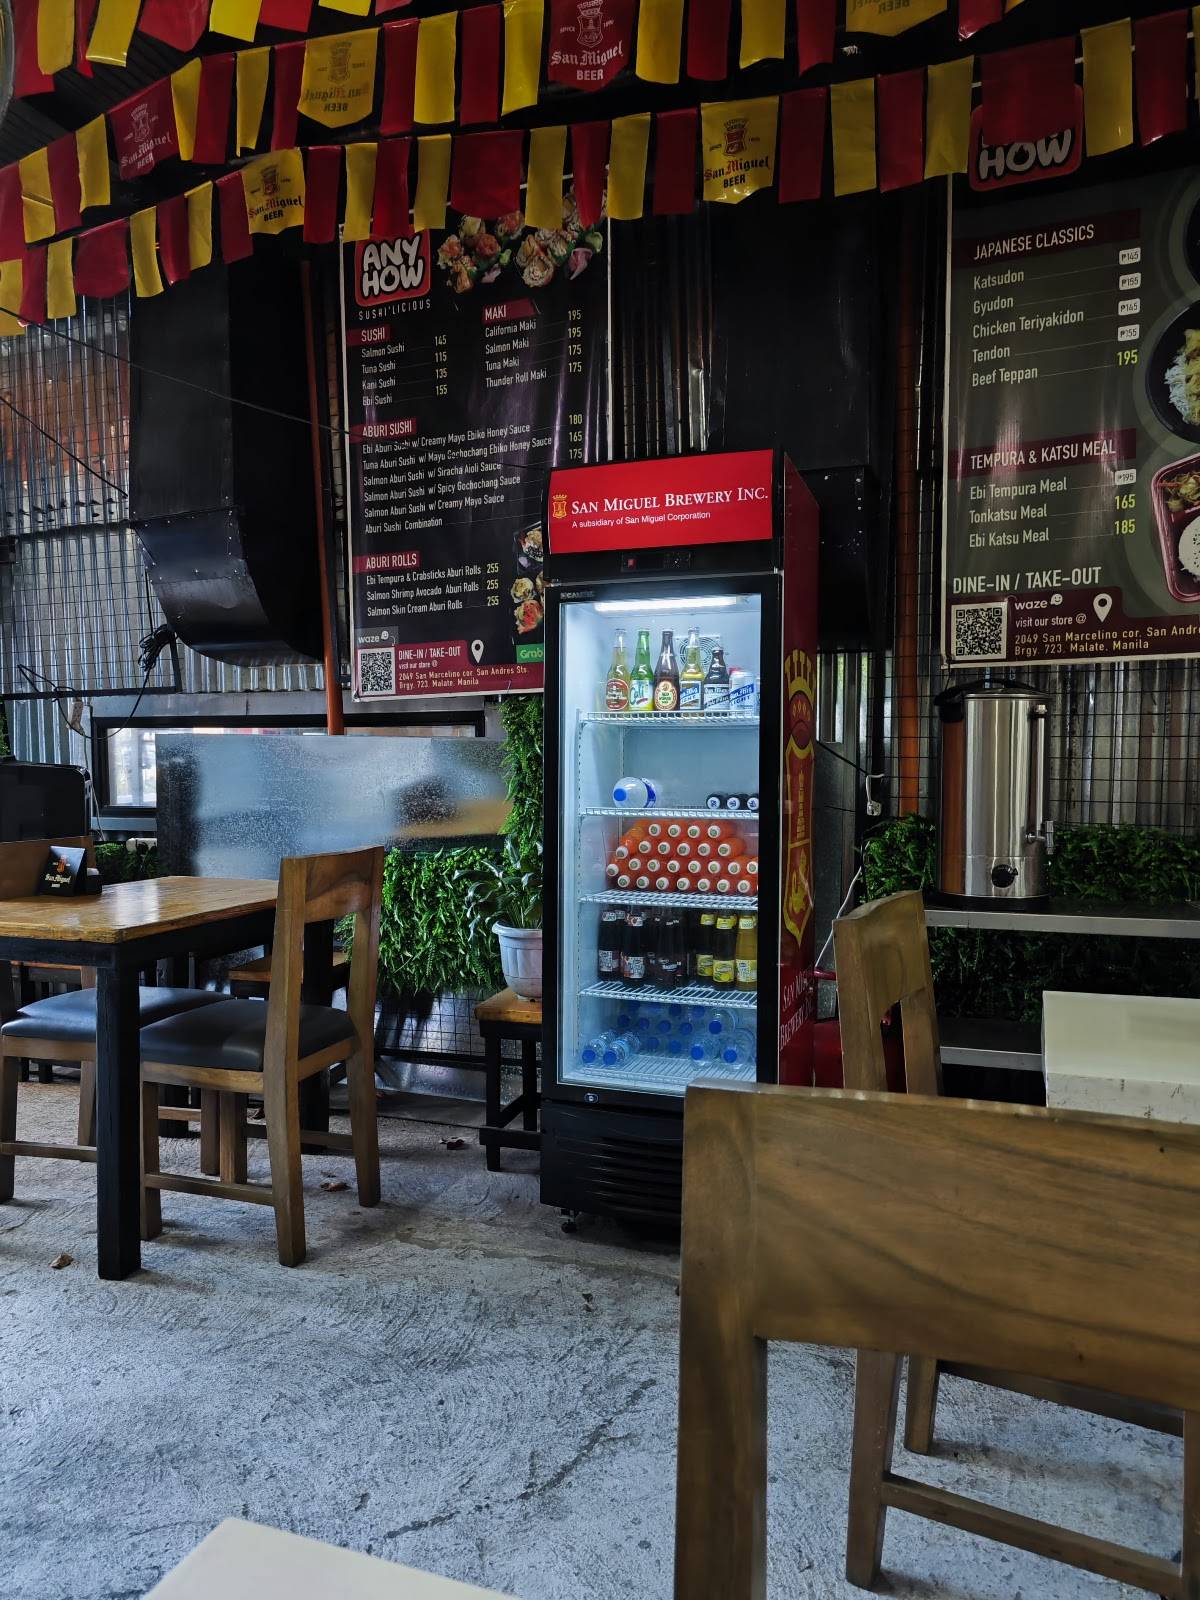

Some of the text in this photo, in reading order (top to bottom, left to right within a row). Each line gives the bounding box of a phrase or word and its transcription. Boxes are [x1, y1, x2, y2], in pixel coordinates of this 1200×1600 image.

[551, 39, 624, 66] San Miguel
[576, 68, 604, 81] BEER
[979, 128, 1072, 180] HOW
[723, 174, 746, 189] BEER
[263, 209, 284, 222] BEER
[973, 223, 1095, 261] JAPANESE CLASSICS
[363, 234, 421, 272] ANY
[362, 258, 424, 298] HOW
[973, 269, 1025, 290] Katsudon
[485, 304, 507, 320] MAKI
[568, 309, 582, 321] 195
[973, 296, 1014, 317] Gyudon
[485, 318, 537, 338] California Maki
[568, 326, 582, 339] 195
[973, 309, 1085, 340] Chicken Teriyakidon
[361, 326, 386, 342] SUSHI
[361, 341, 405, 358] Salmon Sushi
[485, 337, 530, 355] Salmon Maki
[568, 344, 582, 356] 175
[972, 344, 1011, 363] Tendon
[434, 351, 447, 363] 115
[485, 356, 520, 372] Tuna Maki
[1116, 349, 1139, 366] 195
[362, 359, 396, 374] Tuna Sushi
[568, 361, 582, 373] 175
[362, 375, 396, 391] Kani Sushi
[485, 367, 547, 389] Thunder Roll Maki
[972, 367, 1038, 388] Beef Teppan
[362, 392, 393, 406] Ebi Sushi
[435, 384, 448, 397] 155
[568, 413, 583, 425] 180
[362, 419, 412, 438] ABURI SUSHI
[568, 431, 583, 443] 165
[362, 423, 530, 455] Ebi Aburi Creamy Mayo Honey Sauce
[362, 436, 552, 471] Tuna Aburi Sushi Honey Sauce
[568, 448, 583, 460] 175
[970, 438, 1117, 470] TEMPURA & KATSU MEAL
[363, 460, 501, 487] Salmon Aburi Sushi Siracha Sauce
[364, 490, 389, 502] Salmon
[389, 488, 407, 501] Aburi
[408, 485, 425, 498] Sushi
[437, 481, 456, 496] Spicy
[499, 475, 521, 487] Sauce
[970, 476, 1068, 500] Ebi Tempura Meal
[364, 494, 505, 518] Salmon Aburi Sushi Creamy Mayo Sauce
[571, 486, 770, 515] SAN MIGUEL BREWERY INC.
[1114, 493, 1136, 510] 165
[571, 510, 711, 530] A subsidiary of San Miguel Corporation
[969, 503, 1048, 525] Tonkatsu Meal
[365, 517, 443, 534] Aburi Sushi Combination
[1114, 518, 1136, 535] 185
[969, 528, 1050, 548] Ebi Katsu Meal
[366, 553, 417, 570] ABURI ROLLS
[486, 562, 499, 574] 255
[366, 563, 481, 586] Ebi Tempura Crabsticks Aburi Rolls
[952, 566, 1102, 594] DINE-IN / TAKE-OUT
[366, 580, 480, 601] Salmon Shrimp Avocado Aburi Rolls
[486, 579, 499, 590] 255
[367, 599, 463, 617] Salmon Skin Cream Aburi Rolls
[486, 595, 500, 607] 255
[1014, 599, 1049, 611] waze
[1015, 612, 1087, 628] visit our store @
[357, 632, 380, 644] waze
[1014, 633, 1039, 645] 2049
[1042, 632, 1062, 644] San
[1065, 629, 1118, 643] Marcelino
[1146, 626, 1167, 637] San
[398, 646, 462, 661] DINE-IN TAKE-OUT
[1112, 639, 1149, 651] Manila
